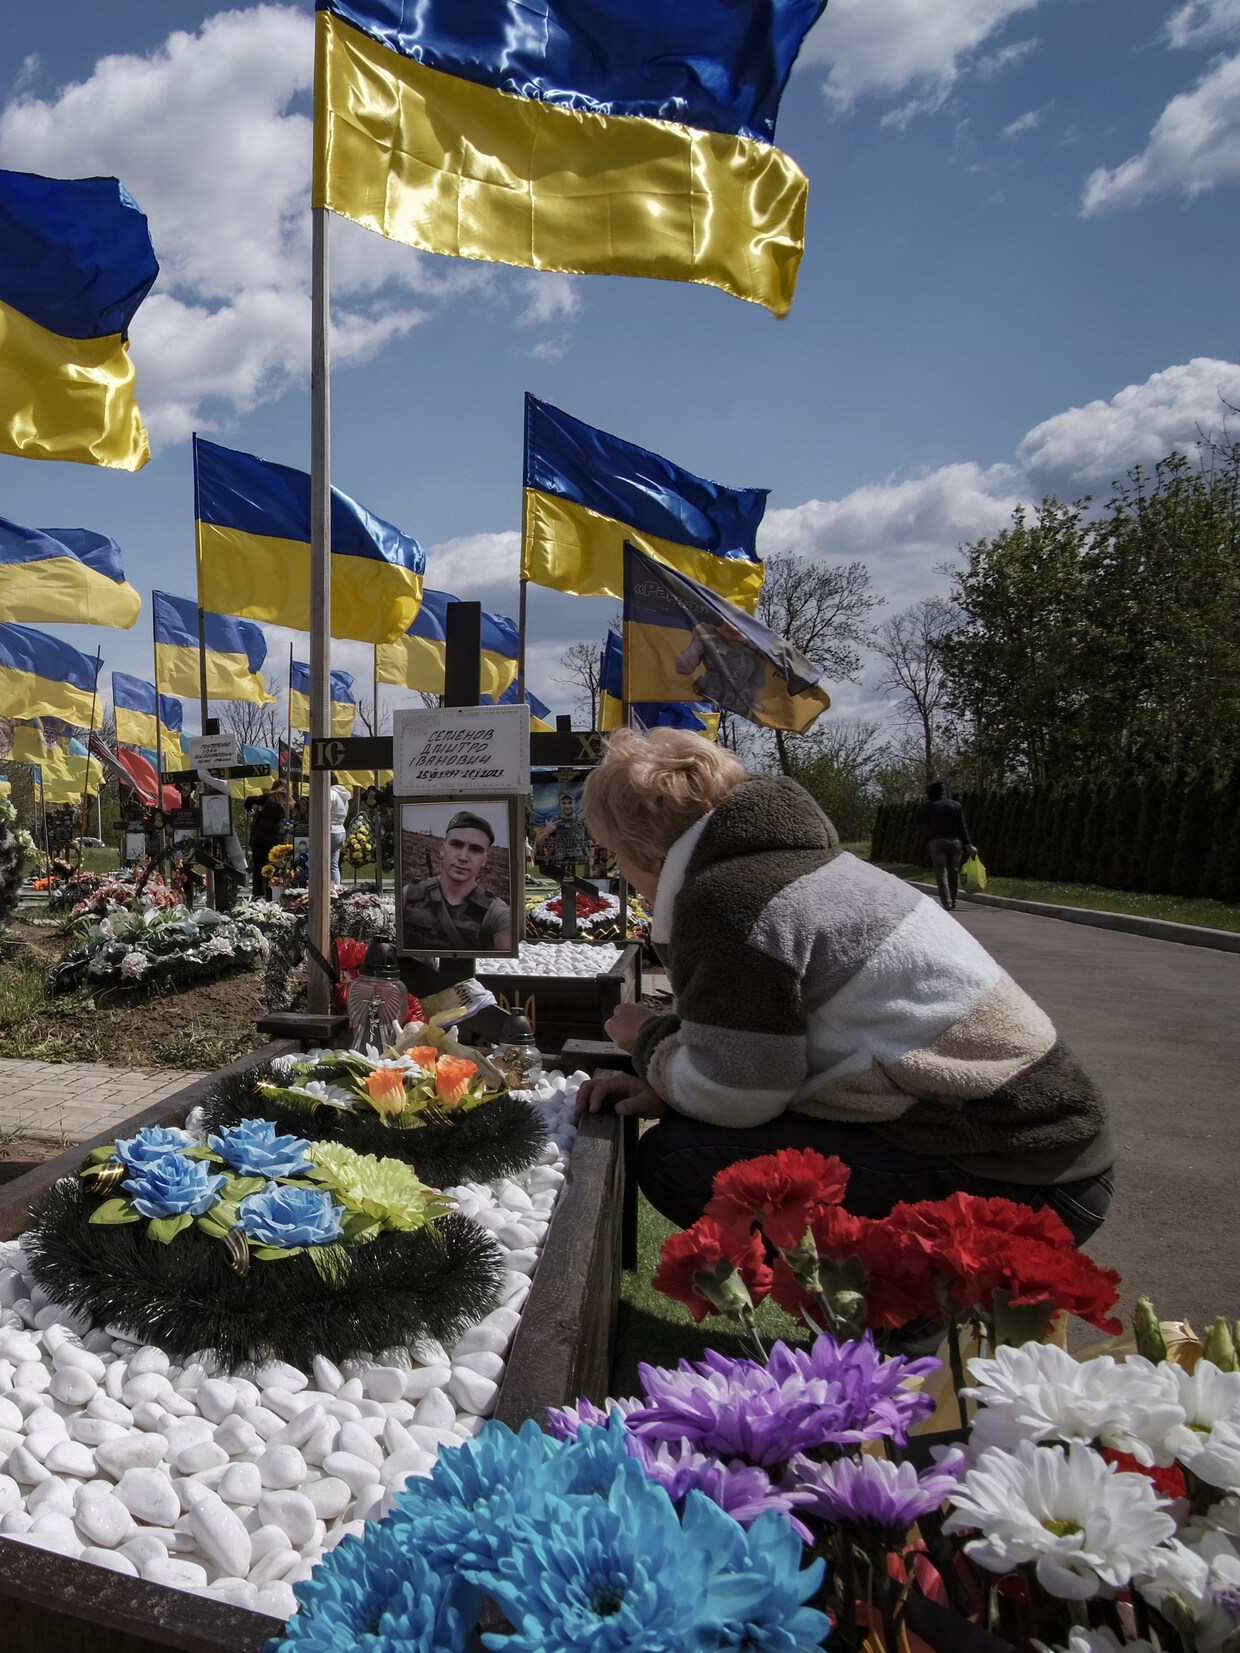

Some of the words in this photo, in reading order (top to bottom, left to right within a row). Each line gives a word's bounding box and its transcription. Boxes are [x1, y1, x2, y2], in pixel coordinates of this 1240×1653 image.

[428, 729, 494, 742] СЕМЕНОВ
[420, 742, 489, 756] ДМИТРО
[409, 755, 491, 767] ІВАНОВИЧ
